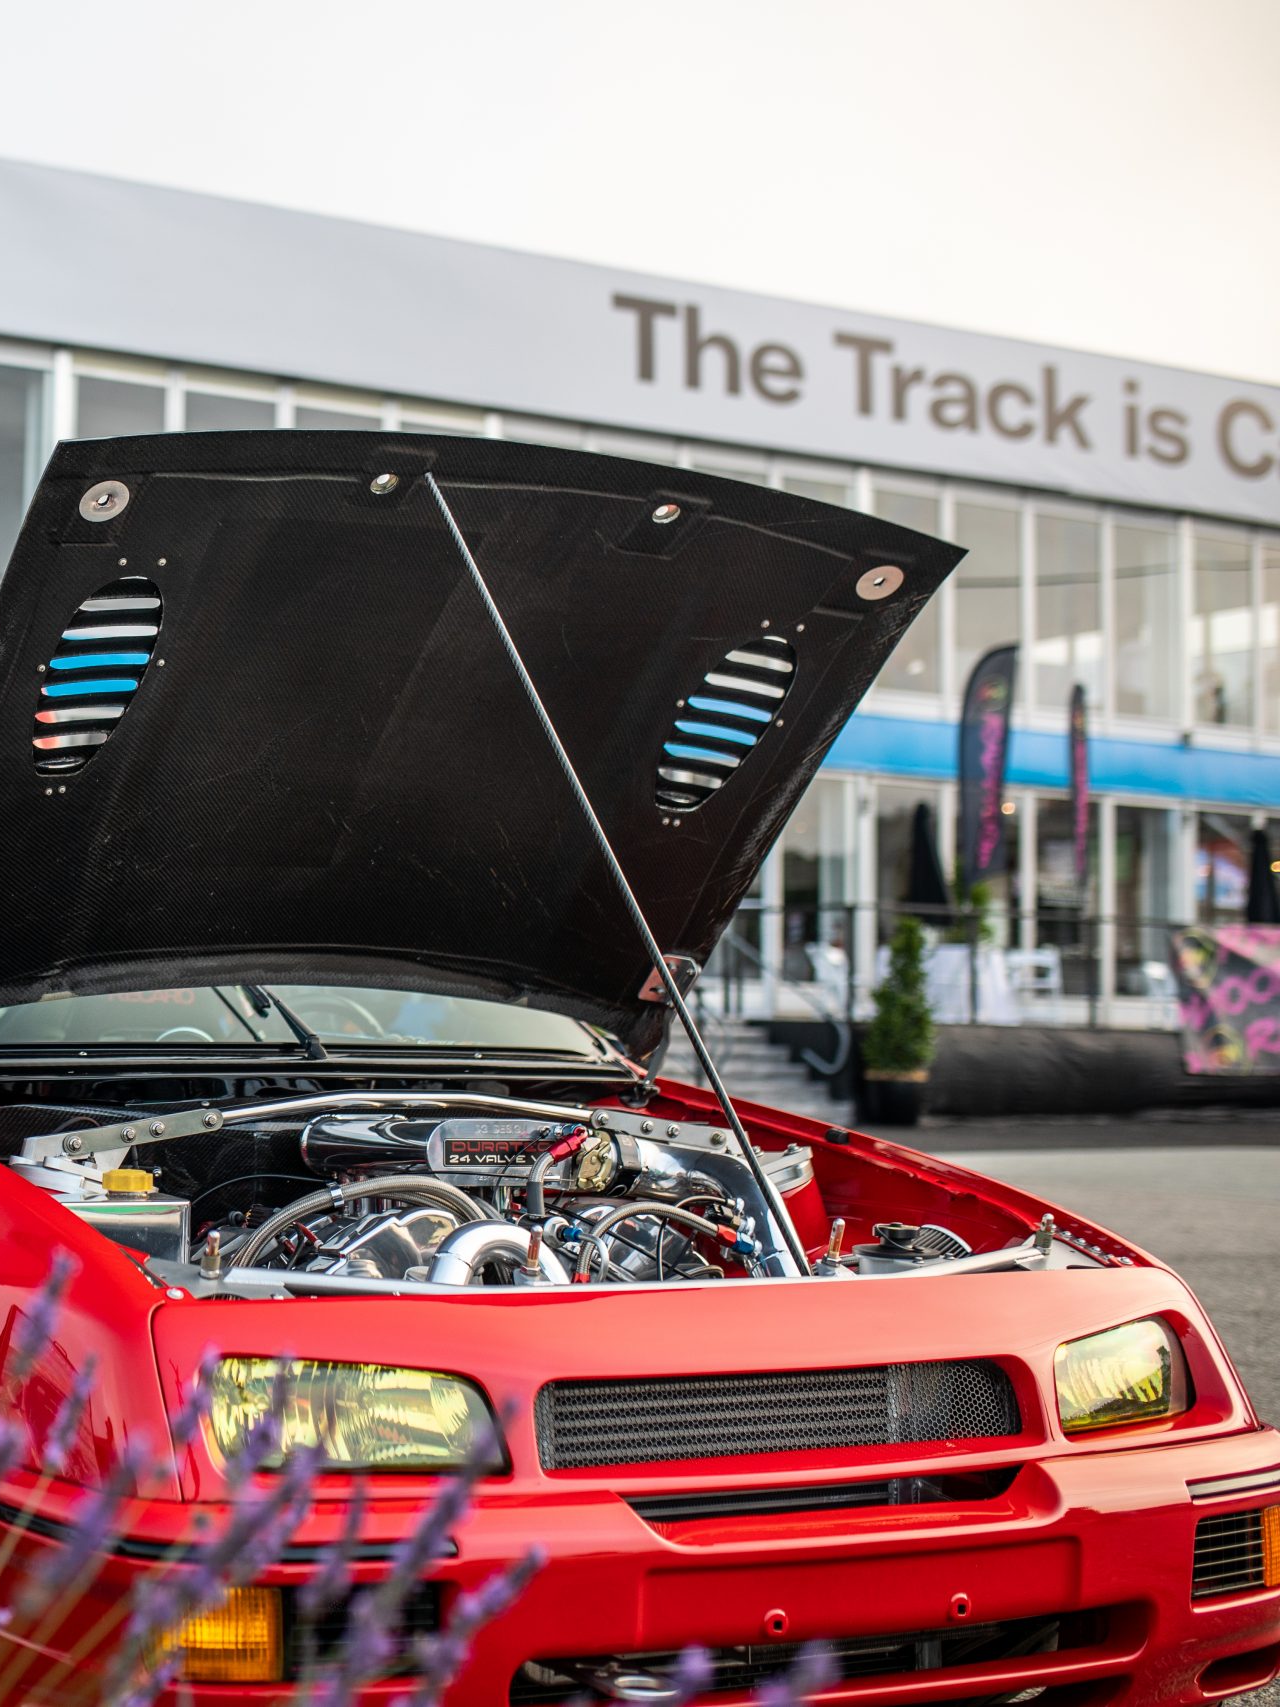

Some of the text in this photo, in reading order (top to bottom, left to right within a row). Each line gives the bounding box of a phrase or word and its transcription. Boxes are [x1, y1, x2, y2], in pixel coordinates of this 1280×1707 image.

[611, 293, 1280, 480] The Track is C
[449, 1154, 471, 1163] 24
[475, 1154, 526, 1163] VALVE
